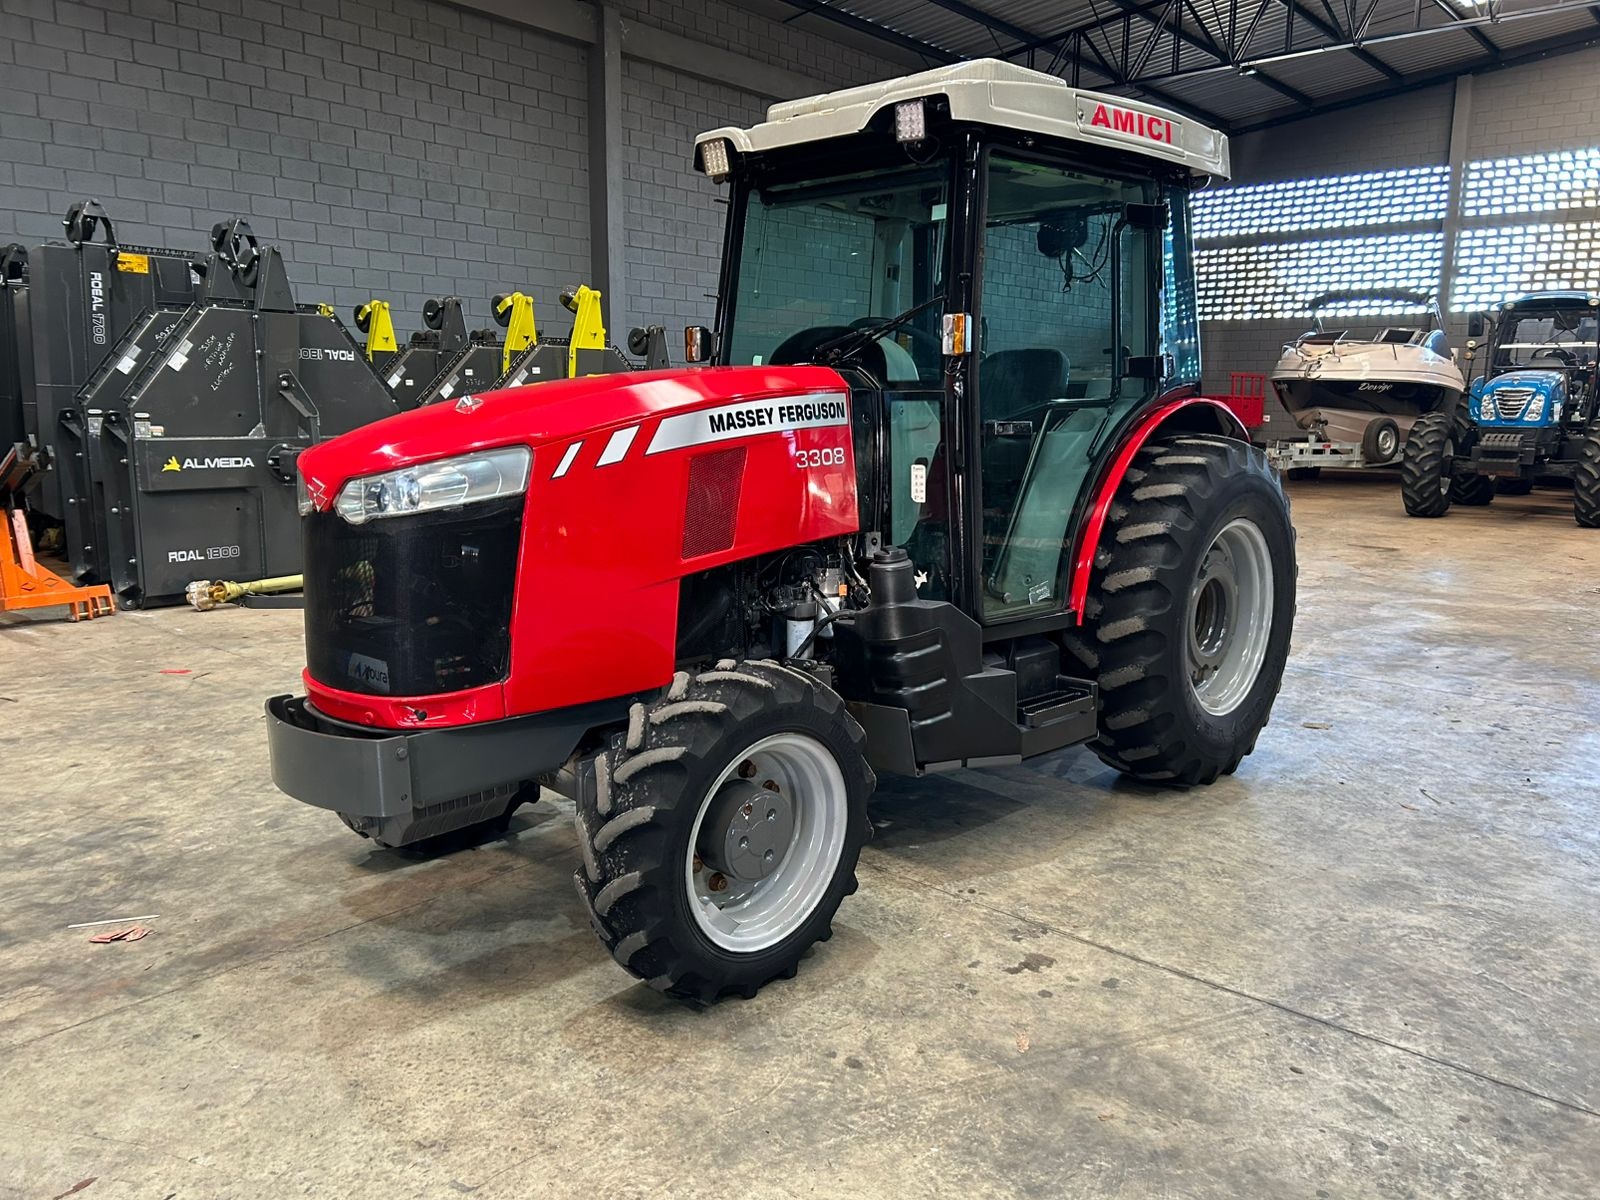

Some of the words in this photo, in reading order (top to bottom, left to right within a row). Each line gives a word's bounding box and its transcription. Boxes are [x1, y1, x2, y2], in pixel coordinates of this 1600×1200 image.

[1091, 102, 1172, 144] AMICI
[90, 271, 105, 312] ROEAL
[92, 313, 106, 345] 1700
[324, 349, 355, 361] ROAL
[709, 407, 774, 433] MASSEY
[778, 402, 846, 424] FERGUSON
[182, 457, 255, 469] ALMEIDA
[795, 447, 845, 468] 3308
[168, 549, 205, 563] ROAL
[207, 545, 240, 560] 1800
